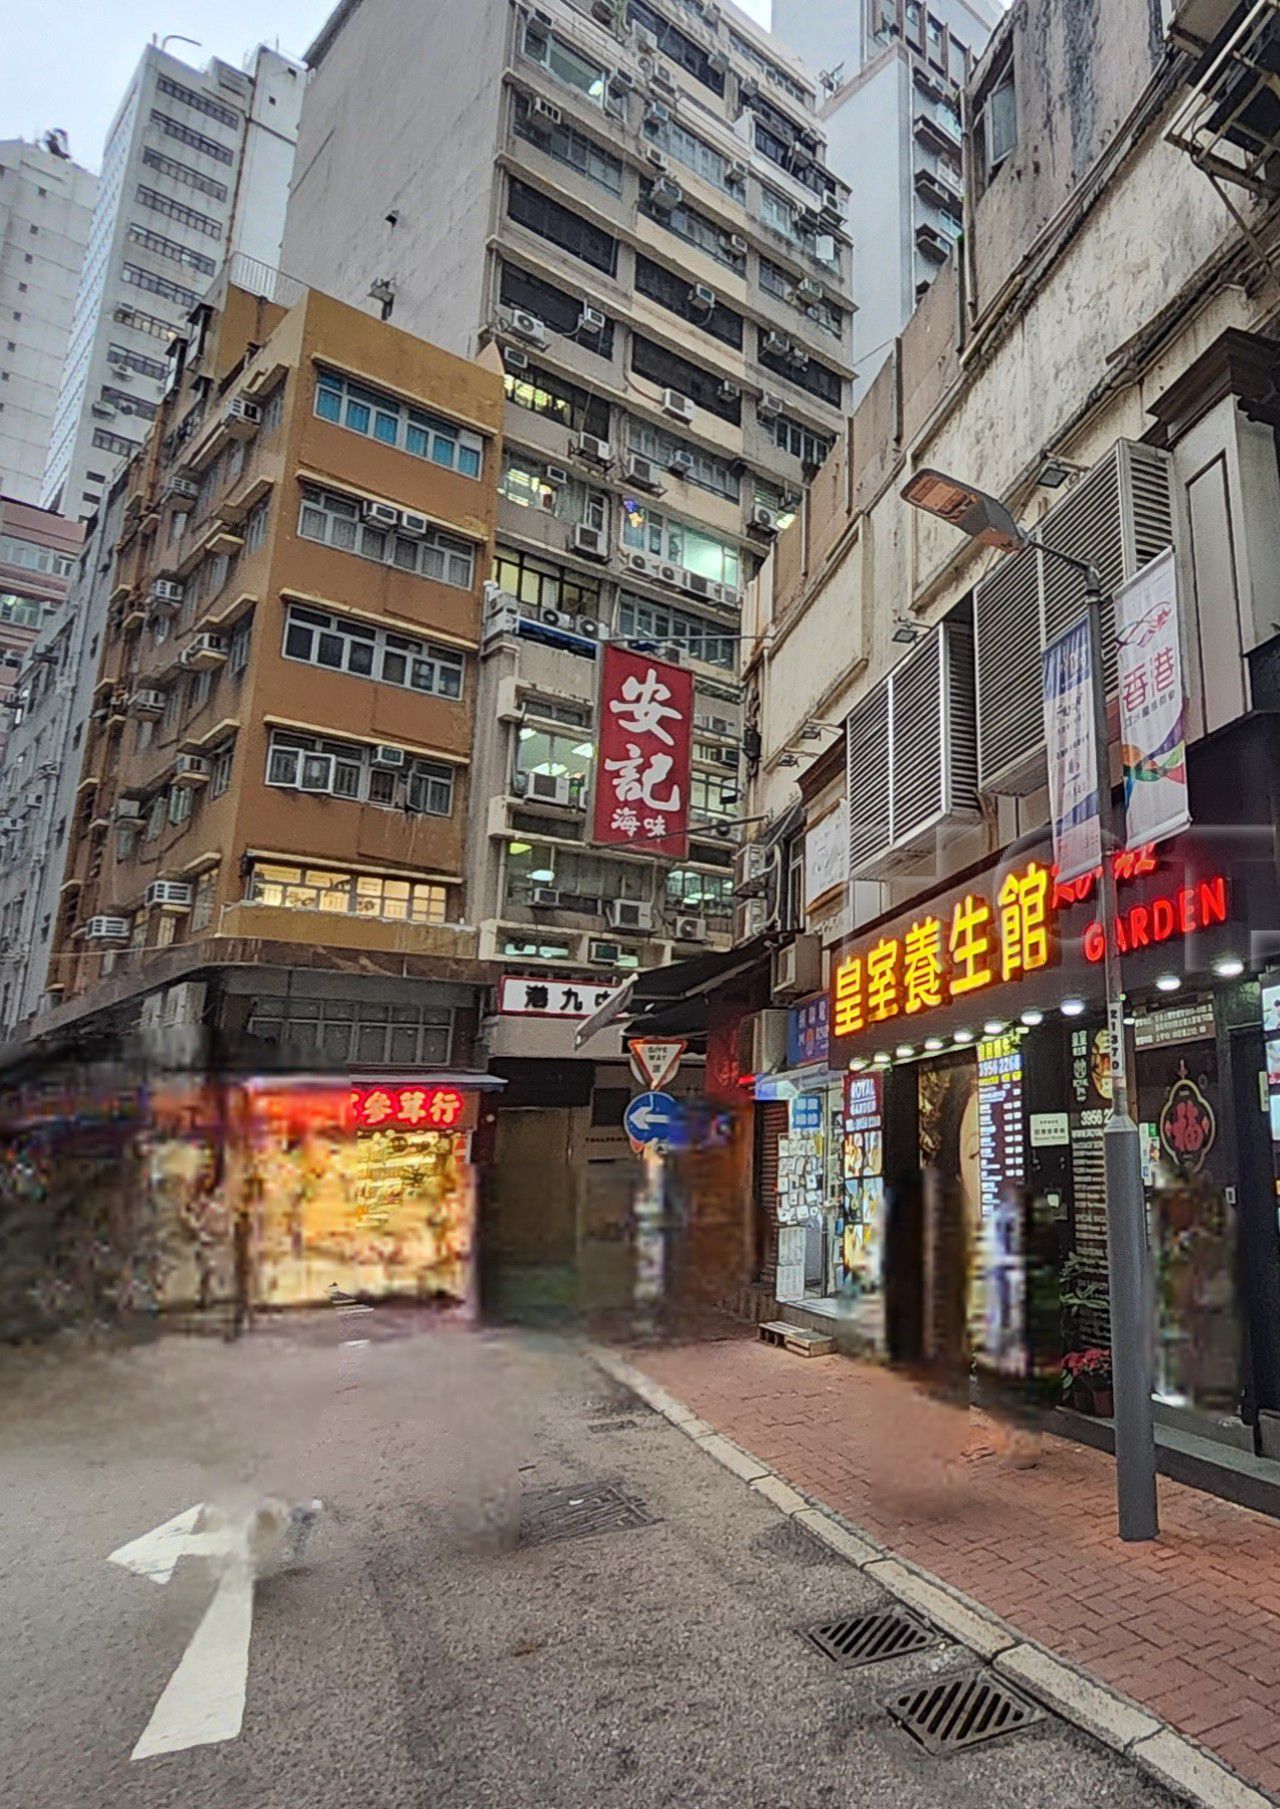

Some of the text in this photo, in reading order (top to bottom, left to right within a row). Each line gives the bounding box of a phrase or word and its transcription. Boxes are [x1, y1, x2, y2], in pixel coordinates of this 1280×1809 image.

[1123, 647, 1176, 712] 香港
[605, 669, 683, 811] 安記
[611, 807, 666, 837] 海味
[833, 862, 1049, 1037] 皇室養生館
[1110, 1009, 1120, 1070] 21370
